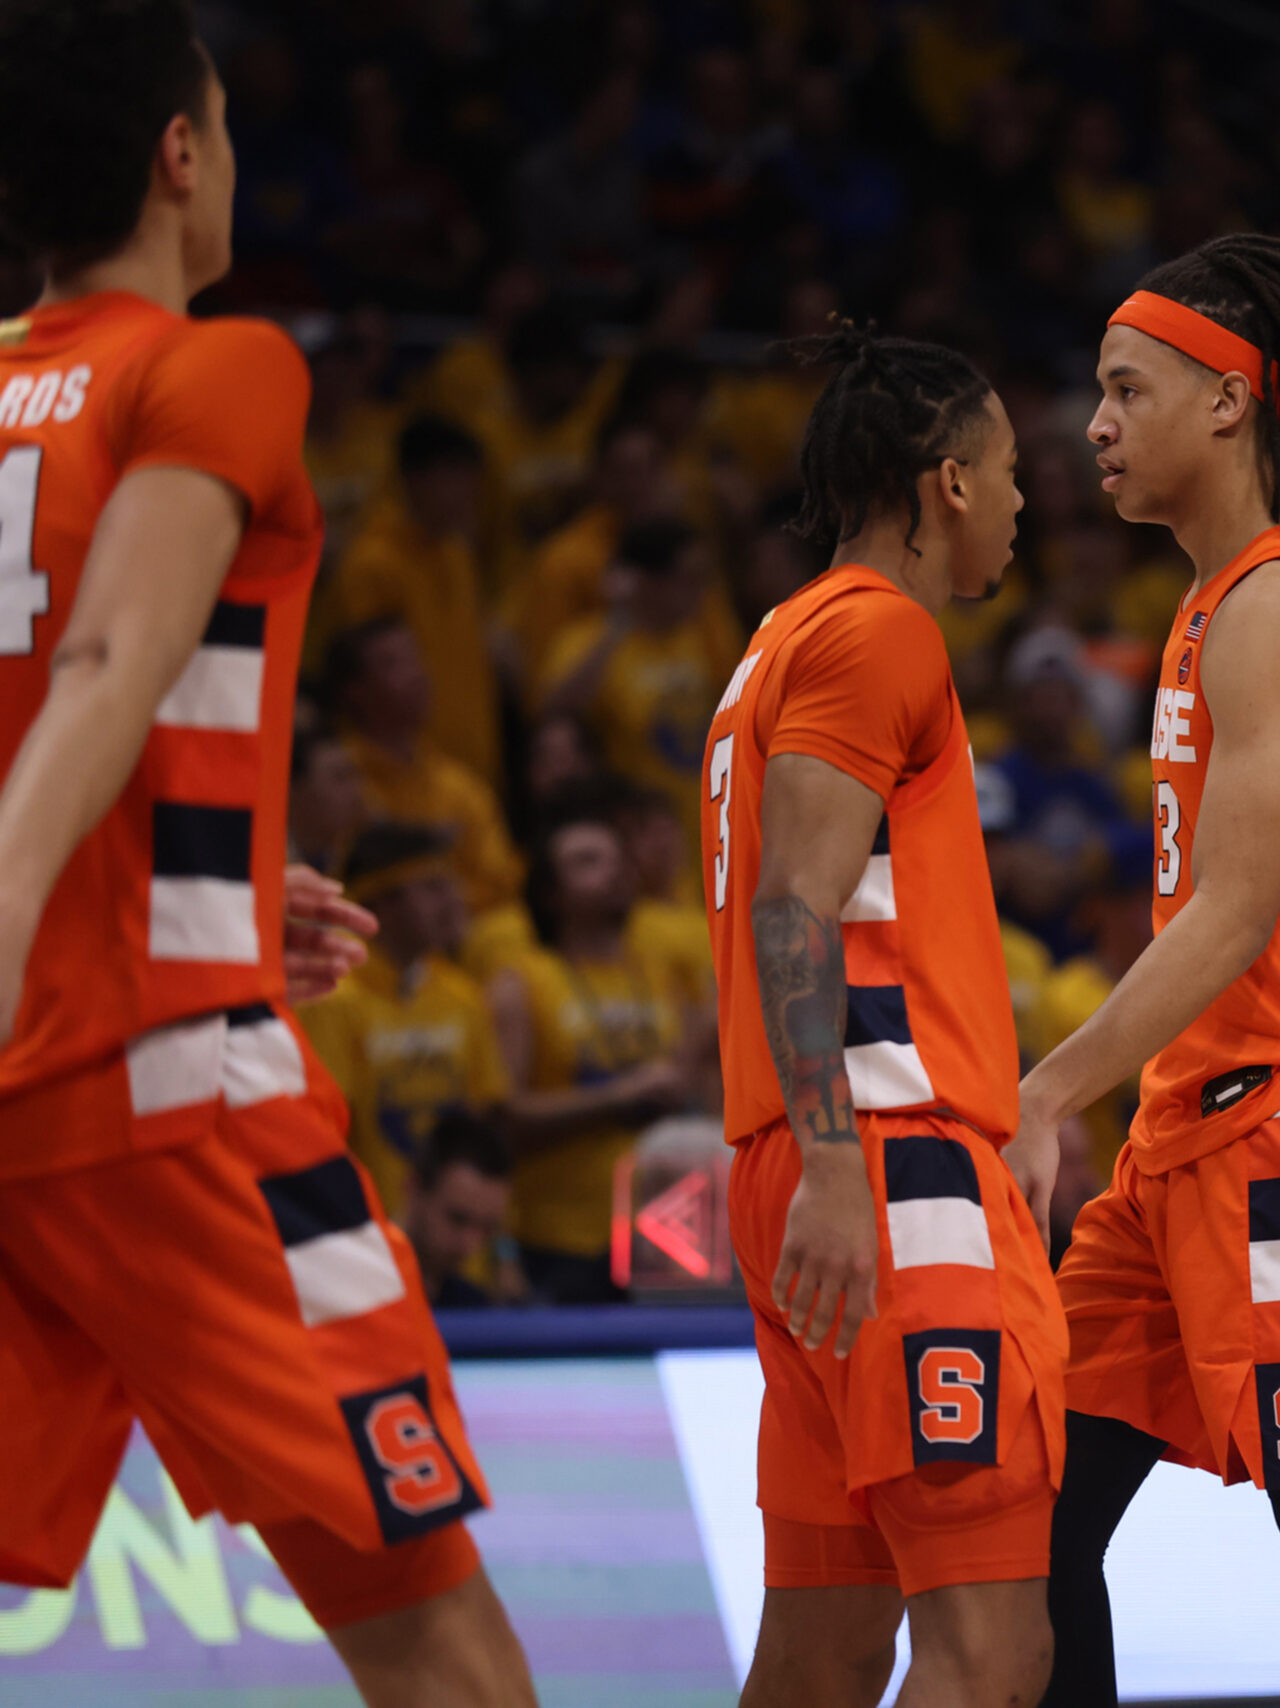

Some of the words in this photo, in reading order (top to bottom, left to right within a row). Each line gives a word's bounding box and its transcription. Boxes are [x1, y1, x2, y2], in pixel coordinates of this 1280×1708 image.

[709, 731, 734, 912] 3
[1152, 780, 1181, 896] 3
[364, 1391, 463, 1517] S
[918, 1347, 985, 1444] S
